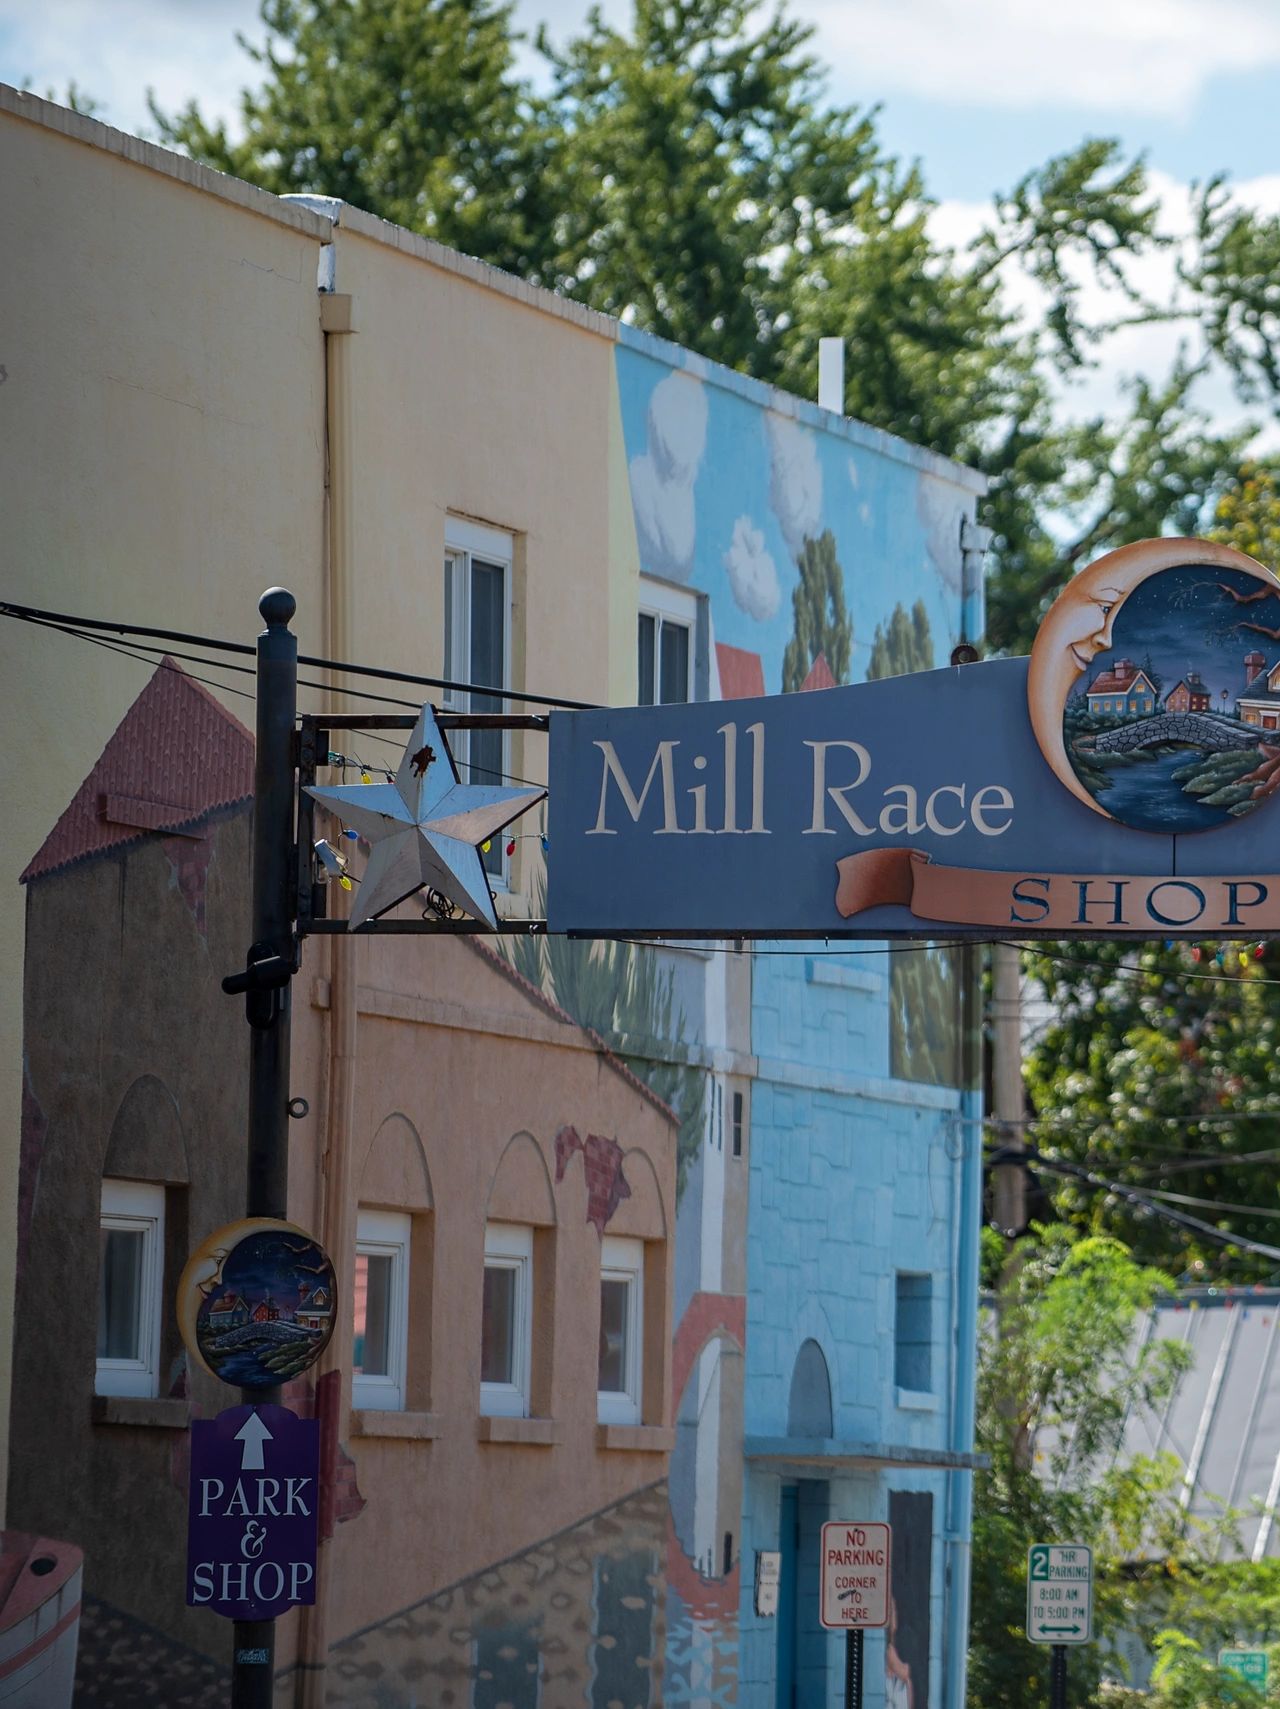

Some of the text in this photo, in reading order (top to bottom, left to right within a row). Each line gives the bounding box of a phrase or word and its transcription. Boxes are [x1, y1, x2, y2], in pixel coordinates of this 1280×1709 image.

[585, 722, 772, 835] Mill
[802, 740, 1015, 837] Race
[198, 1477, 312, 1517] PARK
[240, 1520, 267, 1559] &
[846, 1530, 866, 1547] NO
[828, 1550, 884, 1566] PARKING
[1033, 1552, 1047, 1576] 2
[1049, 1566, 1089, 1578] PARKING
[192, 1561, 313, 1603] SHOP
[835, 1577, 876, 1589] CORNER
[1040, 1588, 1078, 1600] 8:00 AM
[841, 1608, 869, 1619] HERE
[1033, 1606, 1085, 1618] TO 5:00 PM
